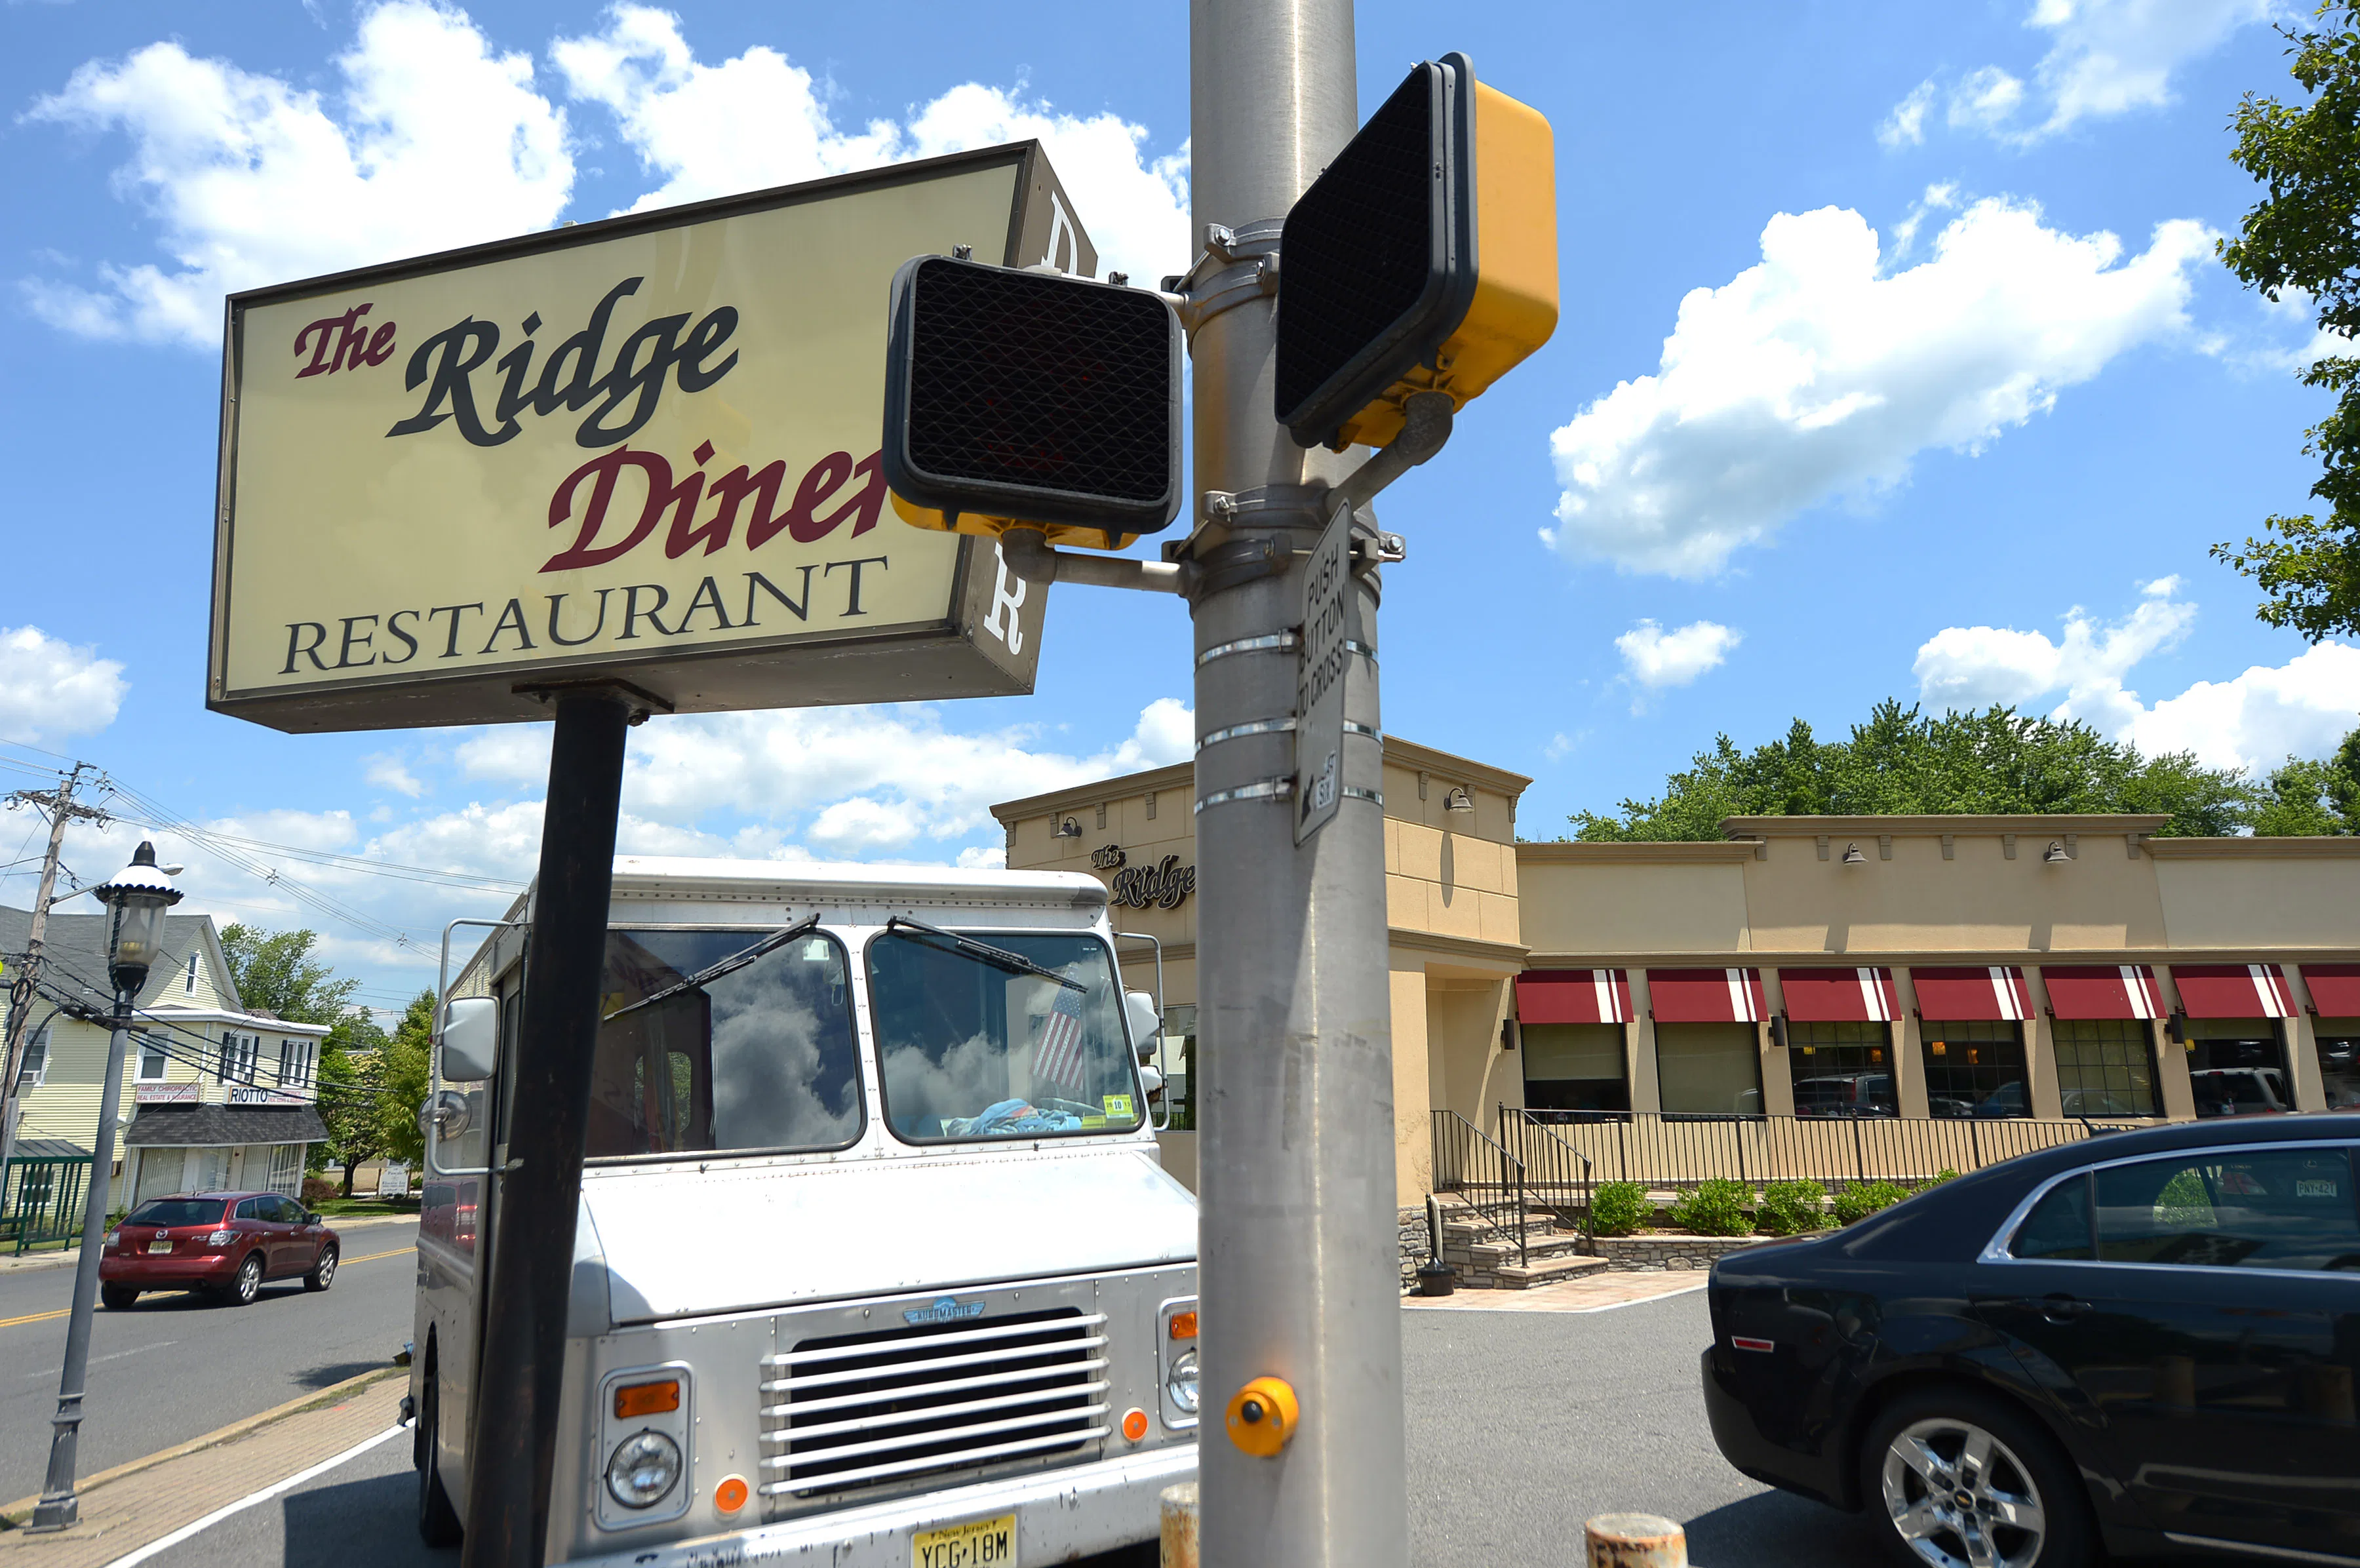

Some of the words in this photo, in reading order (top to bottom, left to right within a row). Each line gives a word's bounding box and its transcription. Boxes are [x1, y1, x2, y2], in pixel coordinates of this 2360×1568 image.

[294, 302, 397, 379] The
[385, 276, 739, 448] Ridge
[538, 438, 889, 574] Diner
[278, 555, 888, 675] RESTAURANT
[1308, 543, 1339, 618] PUSH
[1300, 582, 1346, 675] BUTTON
[1299, 680, 1309, 722] TO
[1310, 637, 1344, 707] CROSS
[1091, 844, 1125, 870] The
[1109, 854, 1196, 910] Ridge
[230, 1088, 268, 1103] RIOTTO
[1114, 1101, 1122, 1109] 10
[939, 1528, 961, 1539] New
[962, 1522, 993, 1536] Jersey
